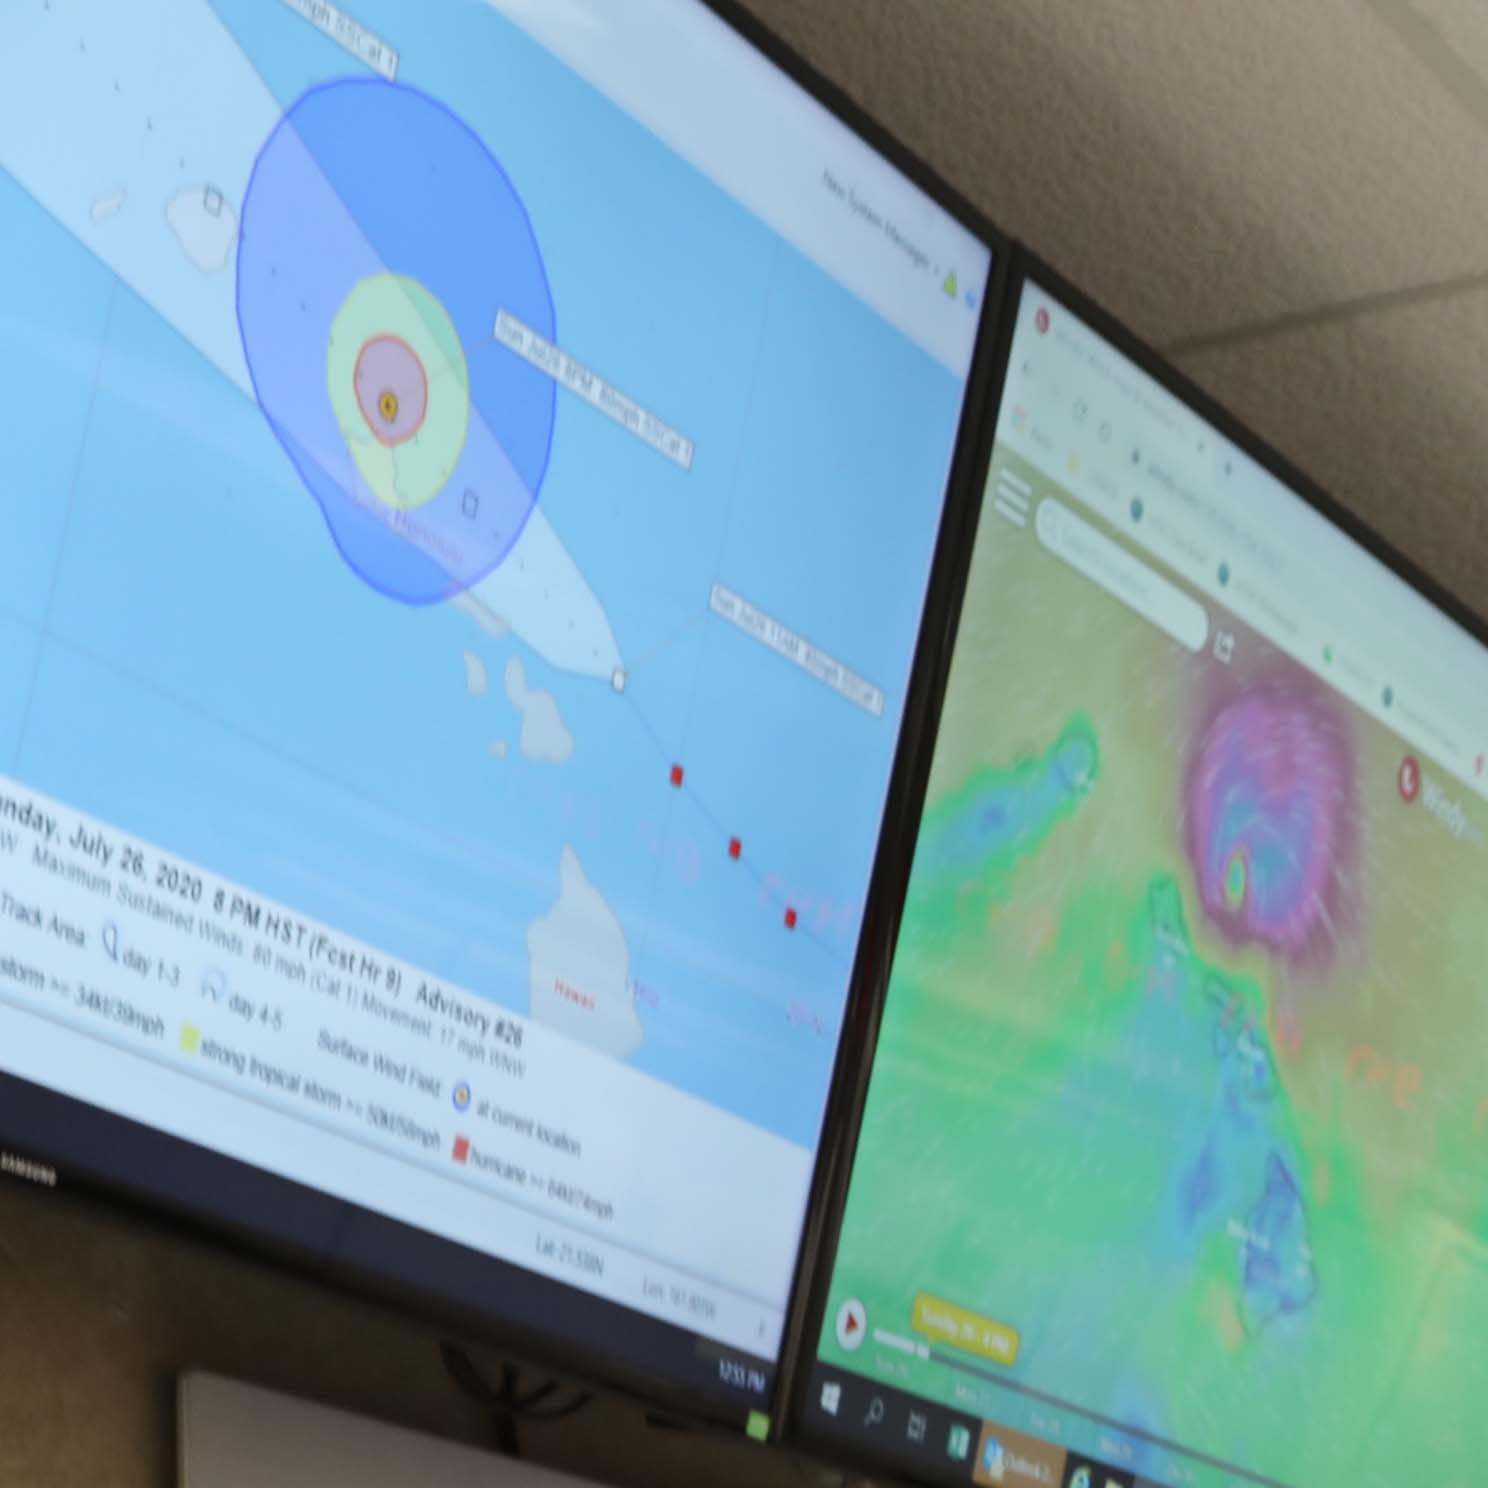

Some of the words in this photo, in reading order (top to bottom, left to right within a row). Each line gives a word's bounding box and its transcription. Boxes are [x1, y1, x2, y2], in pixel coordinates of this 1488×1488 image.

[67, 819, 114, 867] July
[154, 860, 204, 907] 2020
[227, 894, 262, 931] PM
[264, 911, 308, 953] HST
[414, 981, 497, 1041] Advisory
